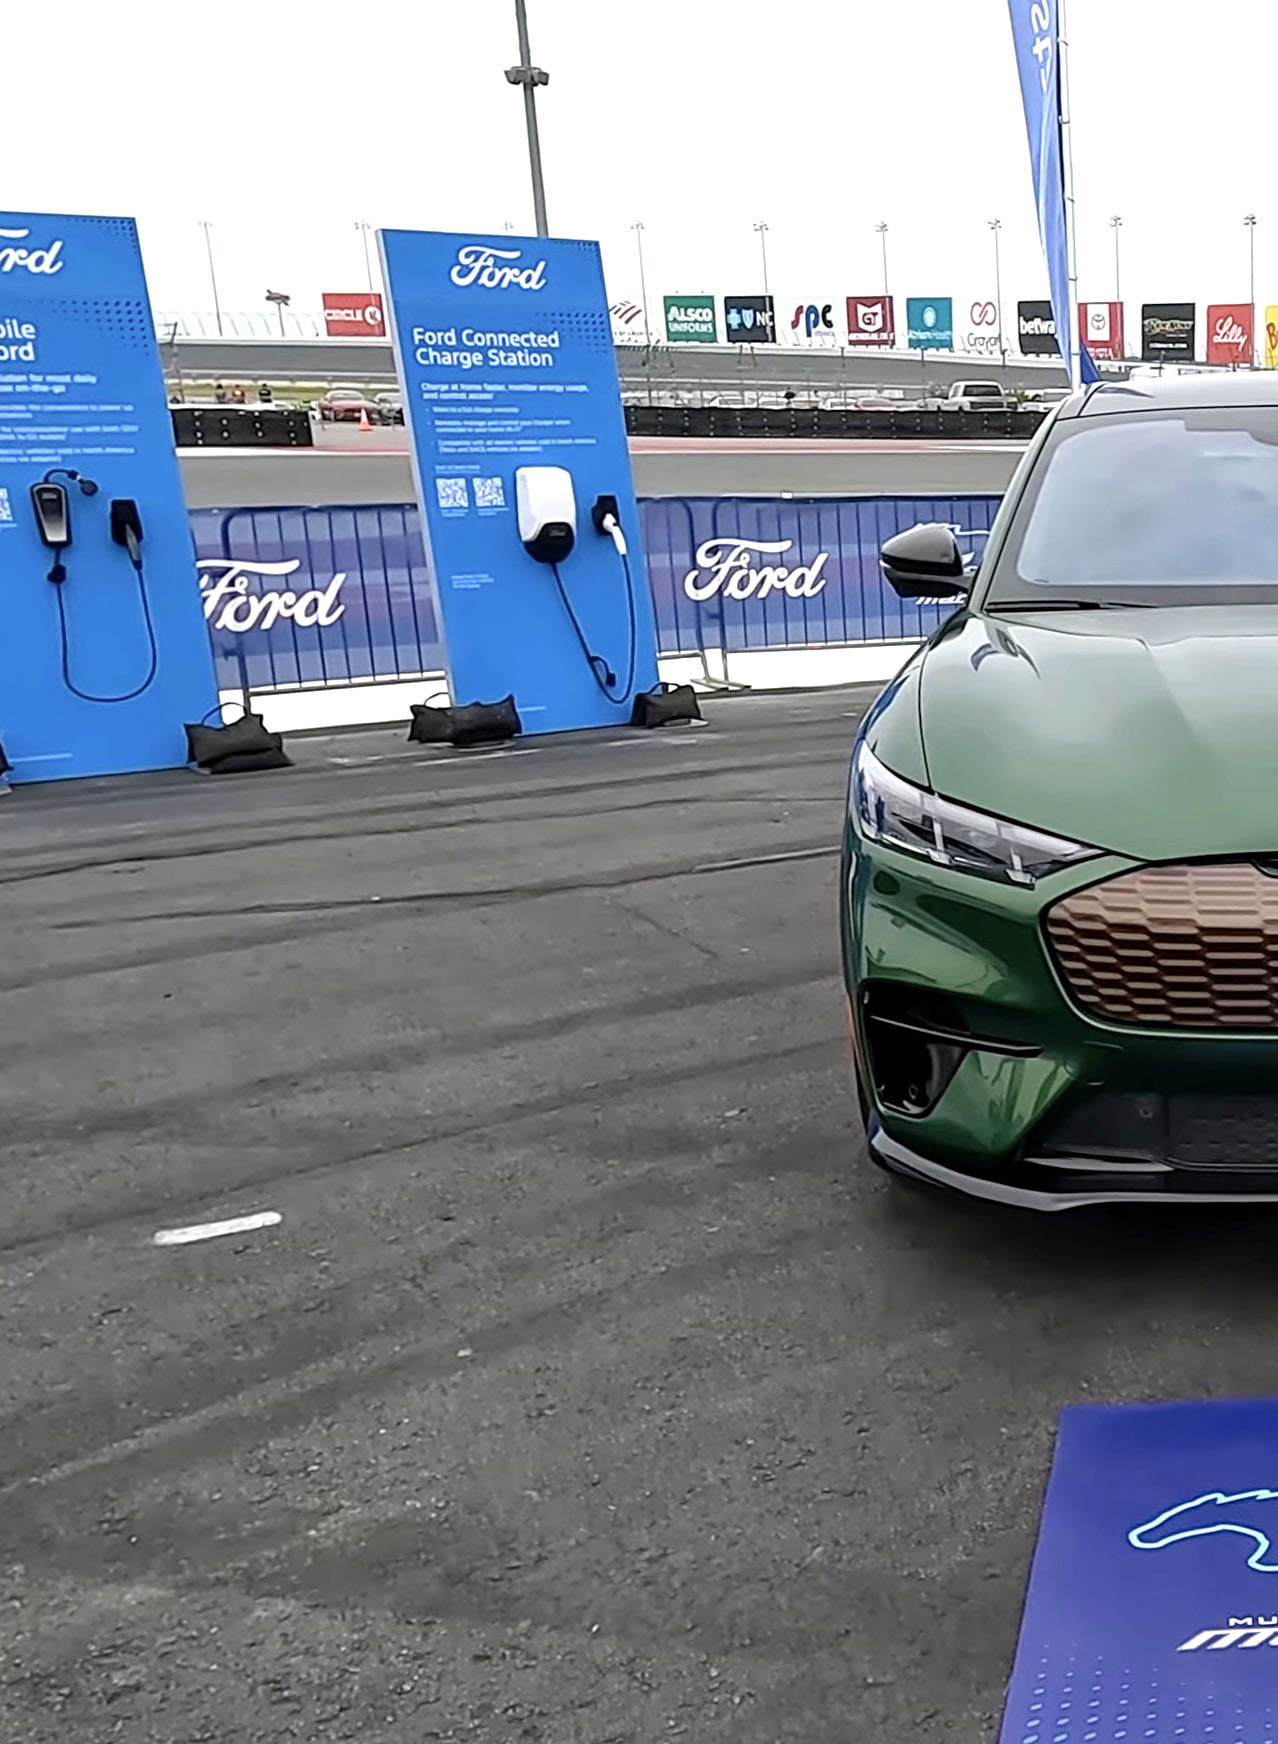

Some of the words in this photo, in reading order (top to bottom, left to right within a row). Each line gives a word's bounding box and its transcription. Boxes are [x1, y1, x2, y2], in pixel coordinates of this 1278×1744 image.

[0, 228, 63, 274] rd
[451, 246, 546, 290] Ford
[667, 305, 713, 323] ALSCO
[412, 327, 456, 346] Ford
[461, 329, 560, 348] Connected
[1020, 316, 1058, 339] betwa
[1212, 315, 1248, 352] Lilly
[0, 341, 36, 361] ord
[415, 347, 484, 369] Charge
[487, 348, 553, 367] Station
[685, 538, 828, 601] Ford
